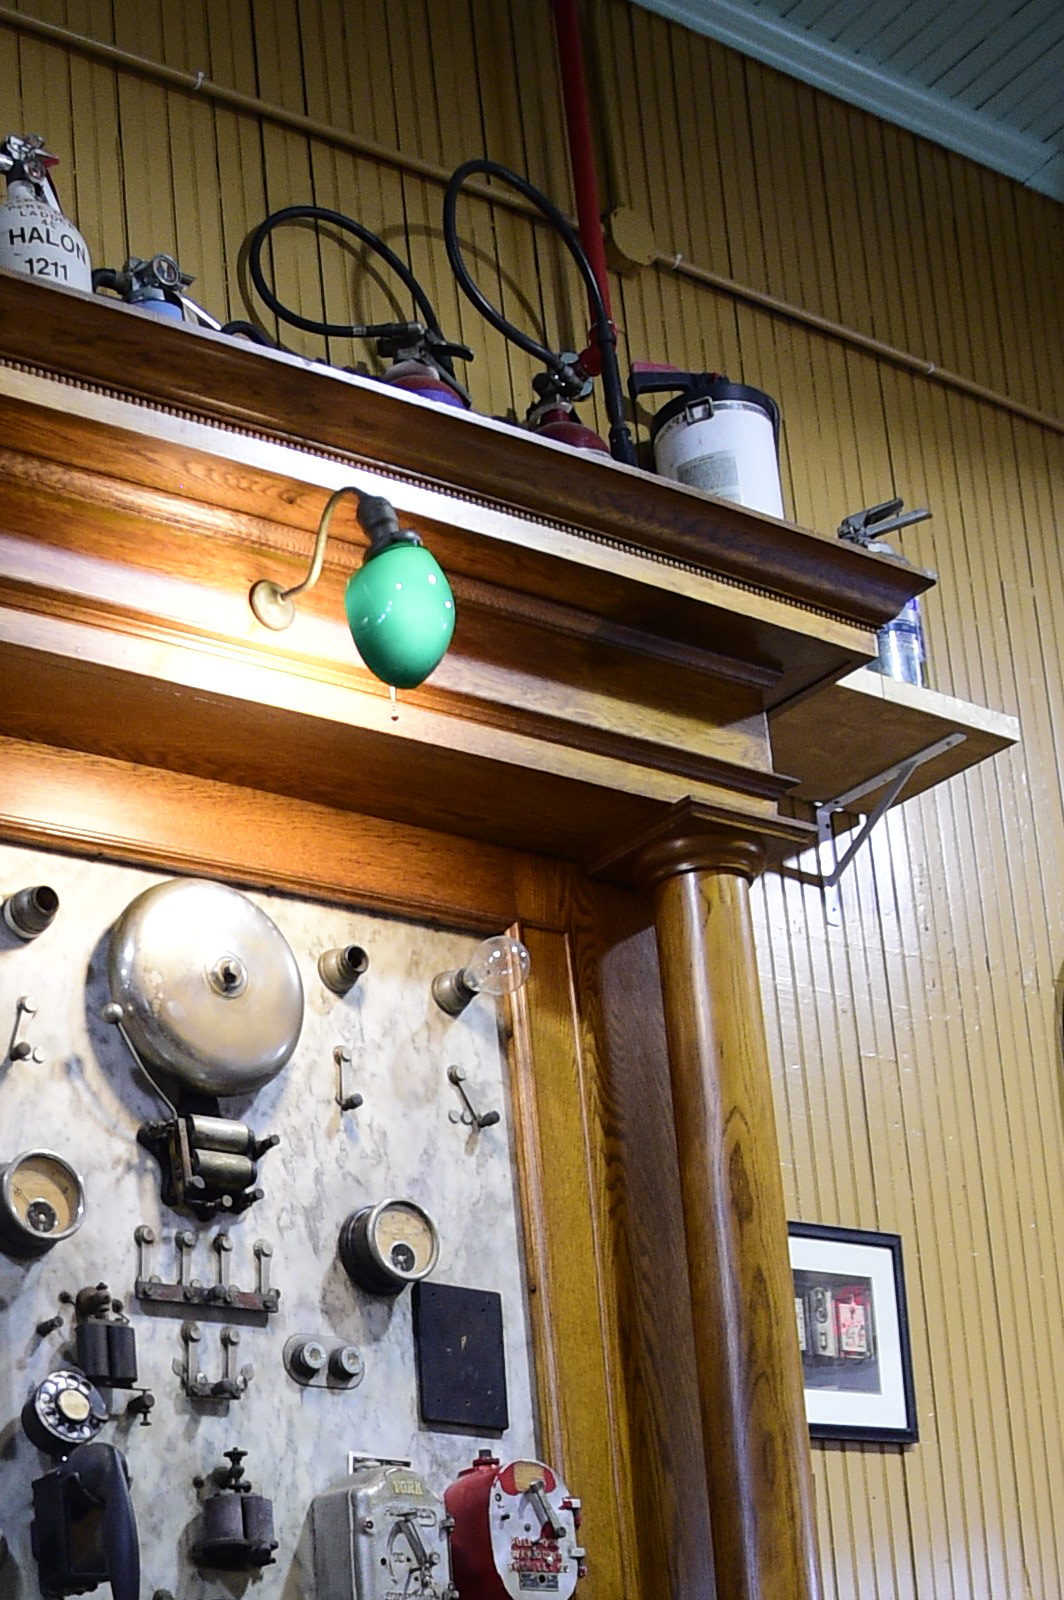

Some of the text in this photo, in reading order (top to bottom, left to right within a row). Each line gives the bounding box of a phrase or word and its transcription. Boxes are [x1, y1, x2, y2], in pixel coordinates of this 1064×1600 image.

[8, 226, 86, 265] HALON
[24, 257, 68, 281] 1211
[393, 1480, 423, 1496] YORK
